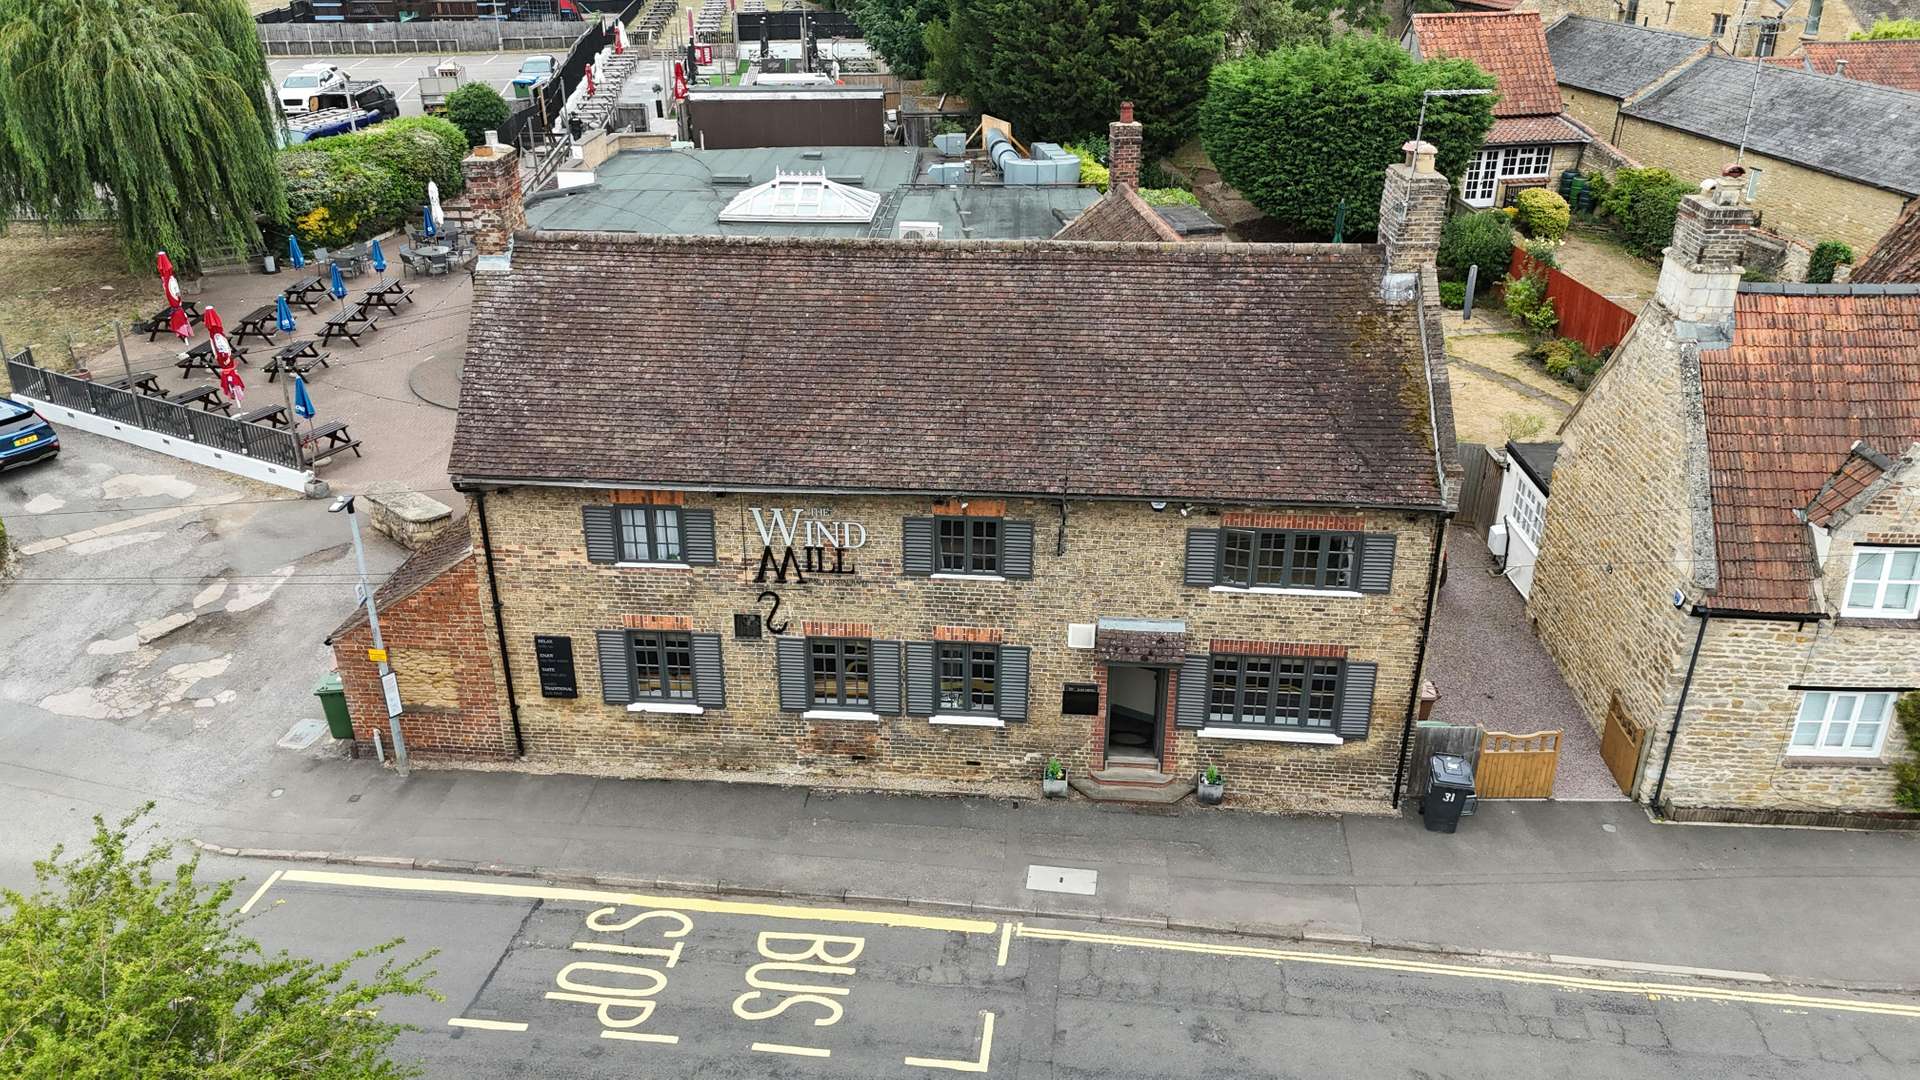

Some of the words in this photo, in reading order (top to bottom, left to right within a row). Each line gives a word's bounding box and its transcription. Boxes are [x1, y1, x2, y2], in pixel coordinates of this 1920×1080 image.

[748, 507, 867, 549] WIND
[811, 507, 832, 517] THE
[752, 545, 856, 584] MILL
[1442, 792, 1456, 803] 31
[544, 906, 694, 1028] STOP
[732, 931, 865, 1026] BUS
